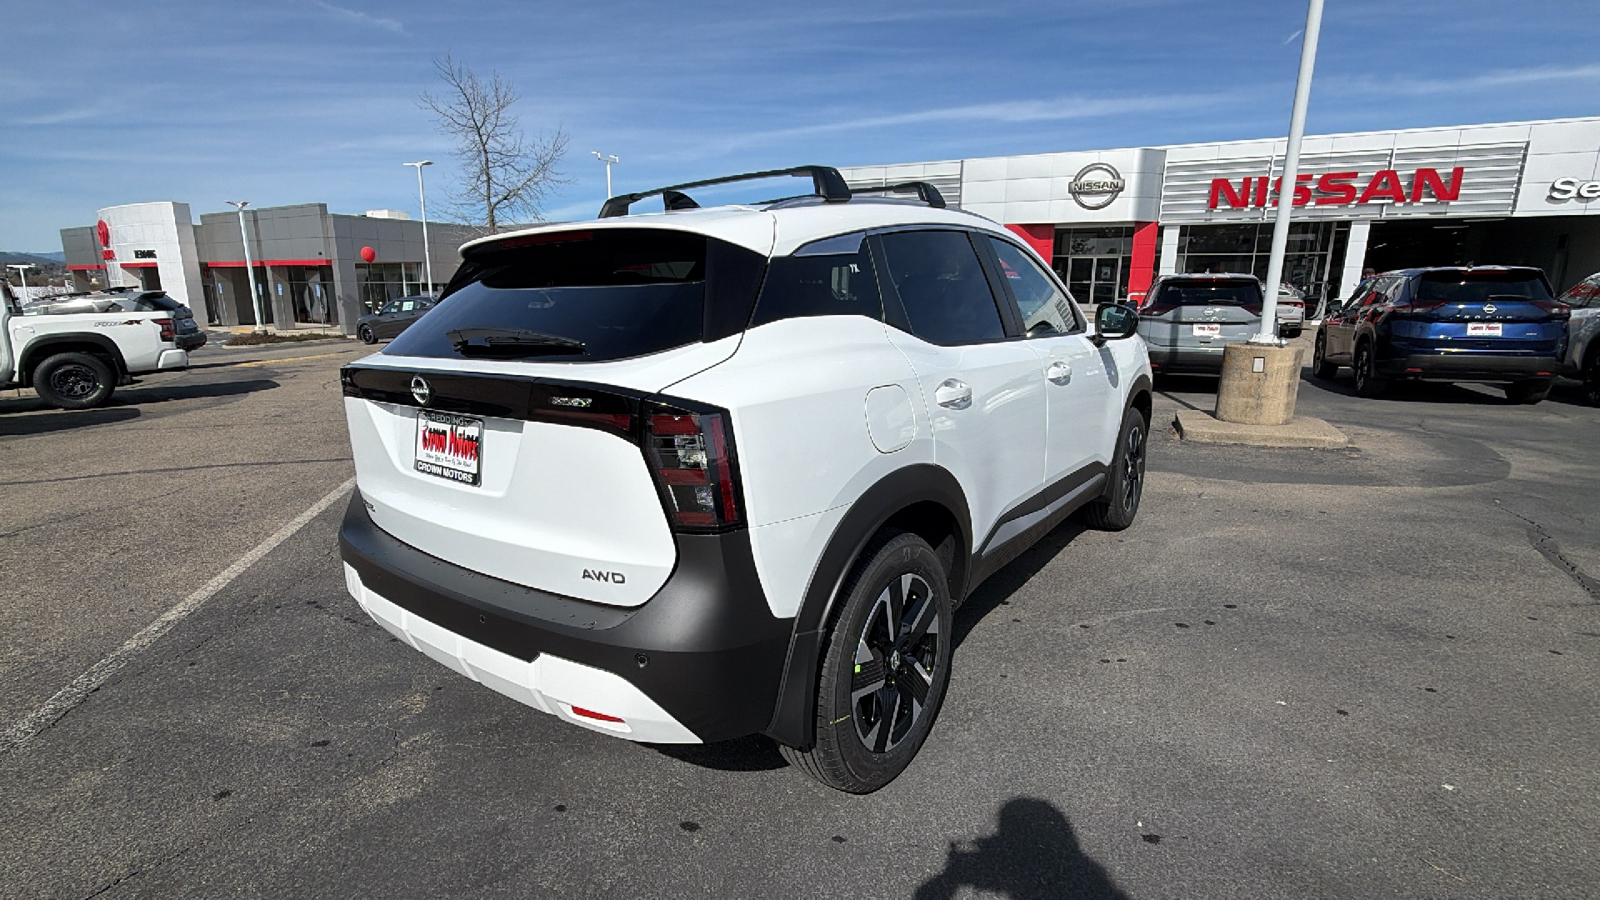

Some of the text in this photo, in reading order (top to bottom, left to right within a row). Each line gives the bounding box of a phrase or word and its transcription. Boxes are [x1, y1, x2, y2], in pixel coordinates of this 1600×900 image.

[1072, 181, 1121, 193] NISSAN
[1208, 167, 1464, 210] NISSAN
[432, 413, 464, 426] REDDING
[448, 425, 479, 461] Motors
[417, 461, 473, 483] CROWN MOTORS
[582, 568, 626, 584] AWD
